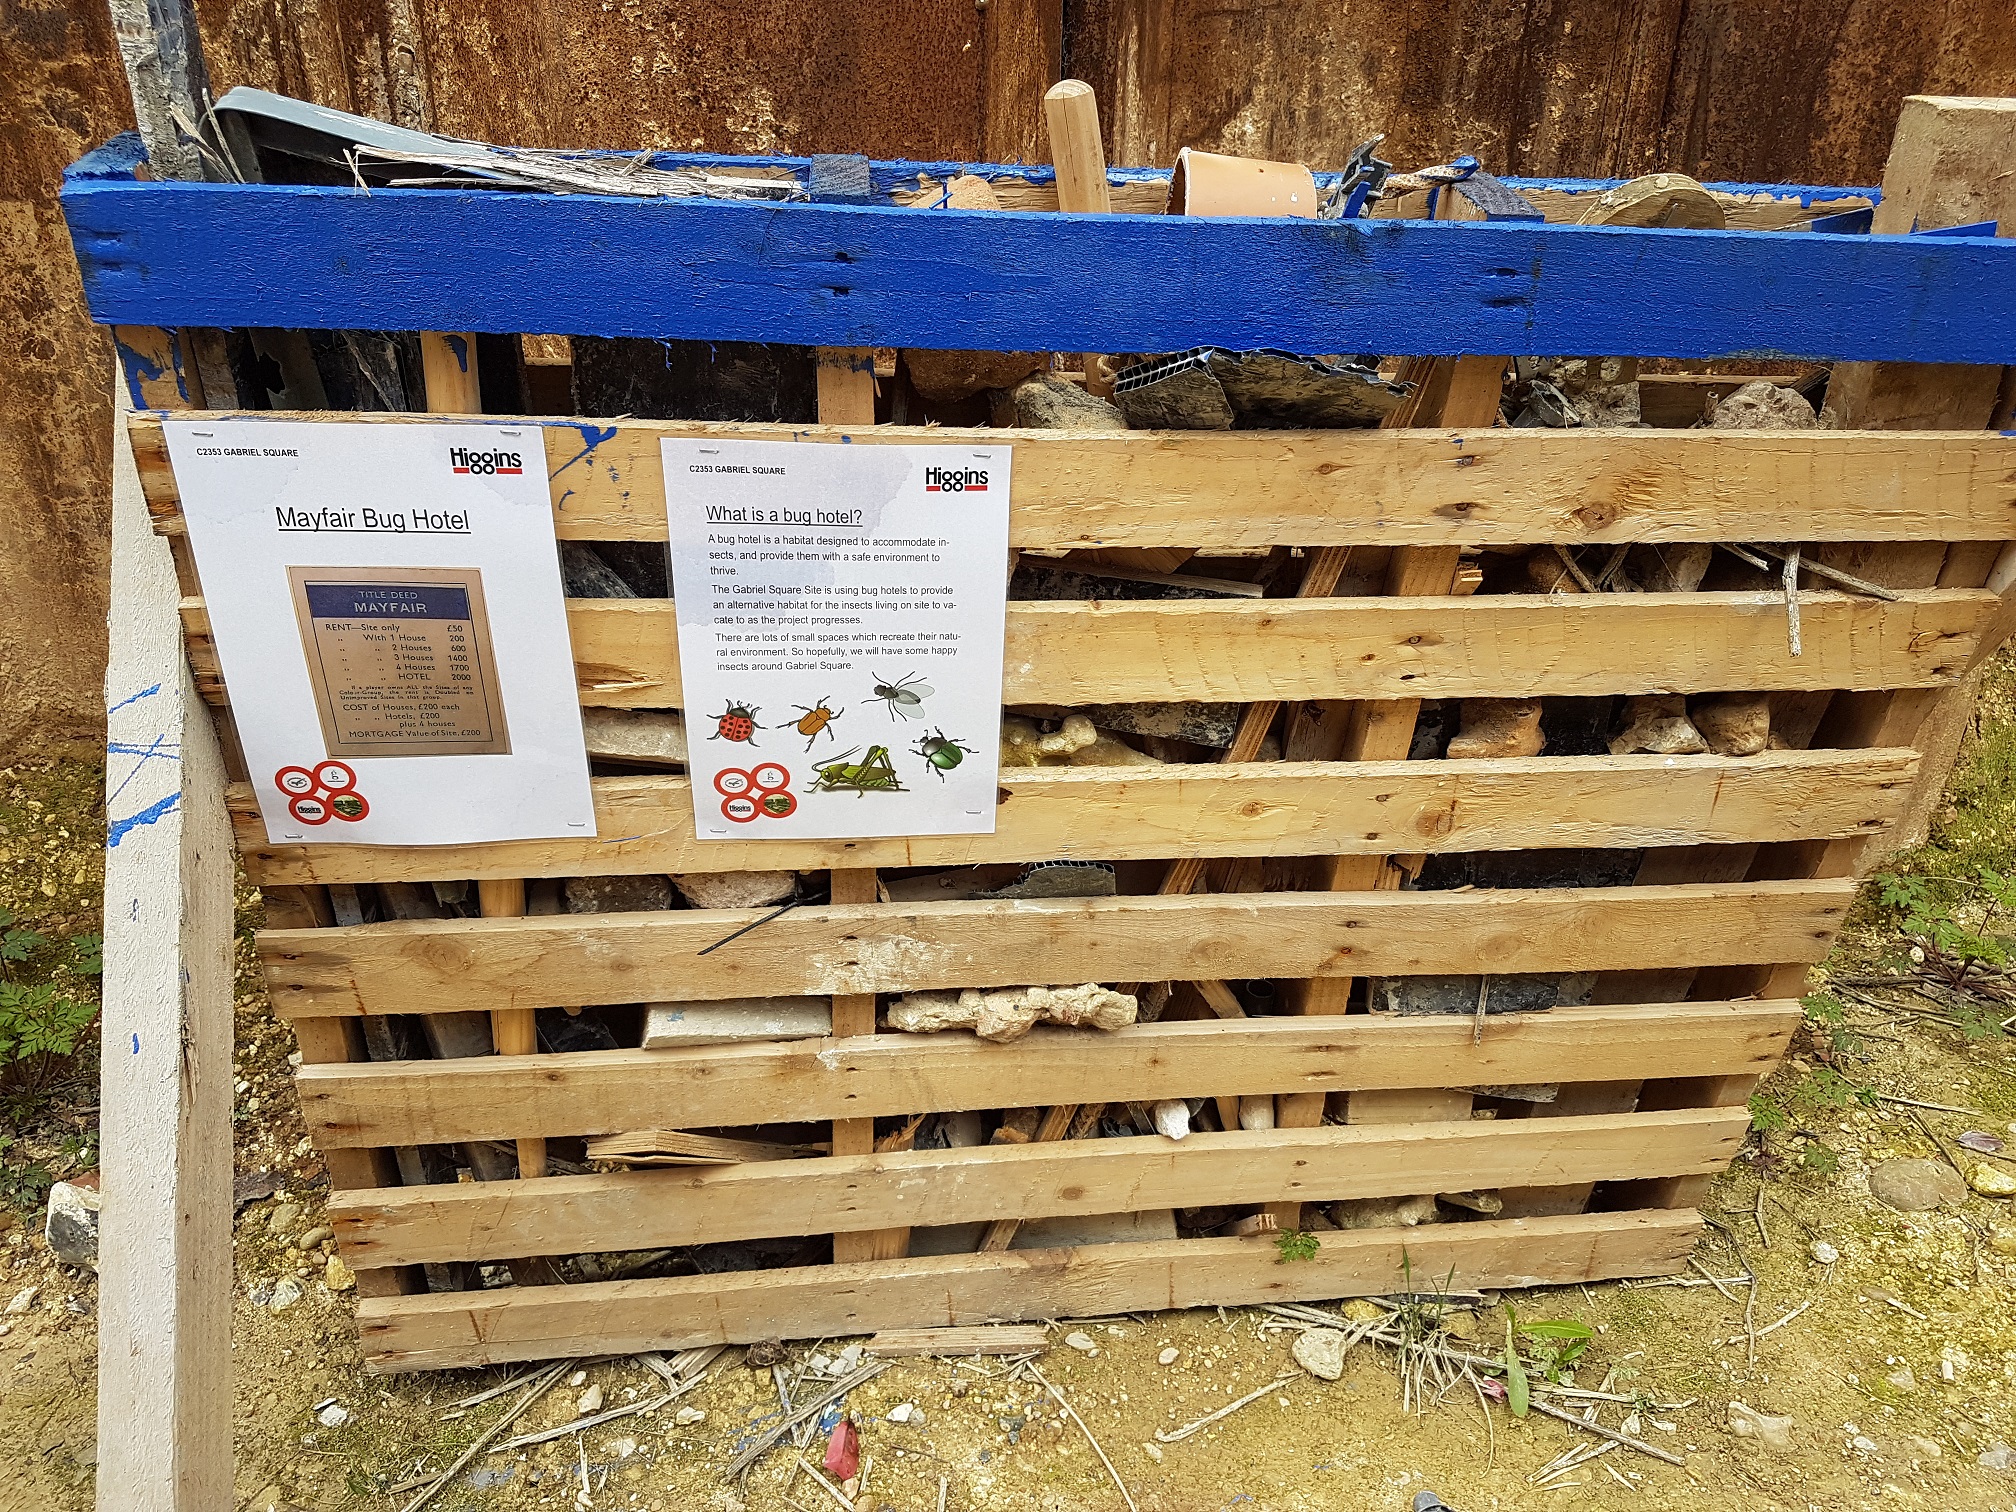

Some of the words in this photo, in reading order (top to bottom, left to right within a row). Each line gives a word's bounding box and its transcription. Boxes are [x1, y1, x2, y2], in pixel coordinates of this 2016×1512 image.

[224, 448, 261, 456] GABRIEL
[263, 449, 298, 457] SQUARE
[450, 448, 522, 474] Higgins
[926, 467, 988, 492] Higgins
[276, 507, 355, 532] Mayfair
[362, 508, 406, 533] Bug
[412, 509, 470, 530] Hotel
[706, 506, 746, 522] What
[751, 506, 764, 522] is
[769, 510, 778, 522] a
[784, 507, 811, 526] bug
[816, 508, 862, 524] hotel?
[708, 534, 716, 543] A
[717, 535, 735, 546] bug
[738, 535, 760, 544] hotel
[764, 535, 771, 544] is
[783, 535, 814, 545] habitat
[816, 536, 858, 548] designed
[860, 537, 870, 546] to
[873, 537, 936, 546] accommodate
[938, 538, 949, 546] in-
[710, 551, 736, 562] sects,
[740, 551, 756, 560] and
[760, 552, 794, 562] provide
[796, 552, 819, 560] them
[822, 552, 840, 560] with
[852, 552, 872, 562] safe
[874, 554, 929, 562] environment
[932, 554, 940, 562] to
[710, 566, 738, 575] thrive.
[712, 585, 729, 594] The
[732, 585, 765, 594] Gabriel
[769, 586, 801, 596] Square
[804, 586, 822, 595] Site
[824, 586, 831, 594] is
[835, 586, 858, 597] using
[862, 586, 878, 597] bug
[880, 586, 907, 595] hotels
[921, 586, 953, 596] provide
[354, 603, 427, 613] MAYFAIR
[727, 600, 774, 610] alternative
[777, 601, 808, 609] habitat
[811, 600, 823, 609] for
[825, 601, 839, 609] the
[842, 601, 872, 609] insects
[875, 600, 897, 612] living
[914, 601, 929, 609] site
[714, 616, 733, 624] cate
[736, 616, 745, 624] to
[761, 616, 775, 624] the
[778, 616, 808, 627] project
[811, 617, 862, 627] progresses.
[381, 625, 400, 633] only
[715, 633, 742, 642] There
[762, 633, 777, 642] lots
[781, 633, 789, 641] of
[792, 633, 815, 641] small
[818, 635, 849, 643] spaces
[852, 633, 876, 641] which
[918, 632, 937, 641] their
[717, 648, 727, 656] ral
[731, 648, 788, 656] environment.
[792, 648, 803, 656] So
[806, 647, 847, 658] hopefully,
[882, 647, 902, 655] have
[932, 647, 958, 657] happy
[718, 662, 748, 671] insects
[752, 662, 782, 671] around
[786, 662, 817, 670] Gabriel
[820, 662, 853, 672] Square.
[730, 804, 751, 812] Higgins
